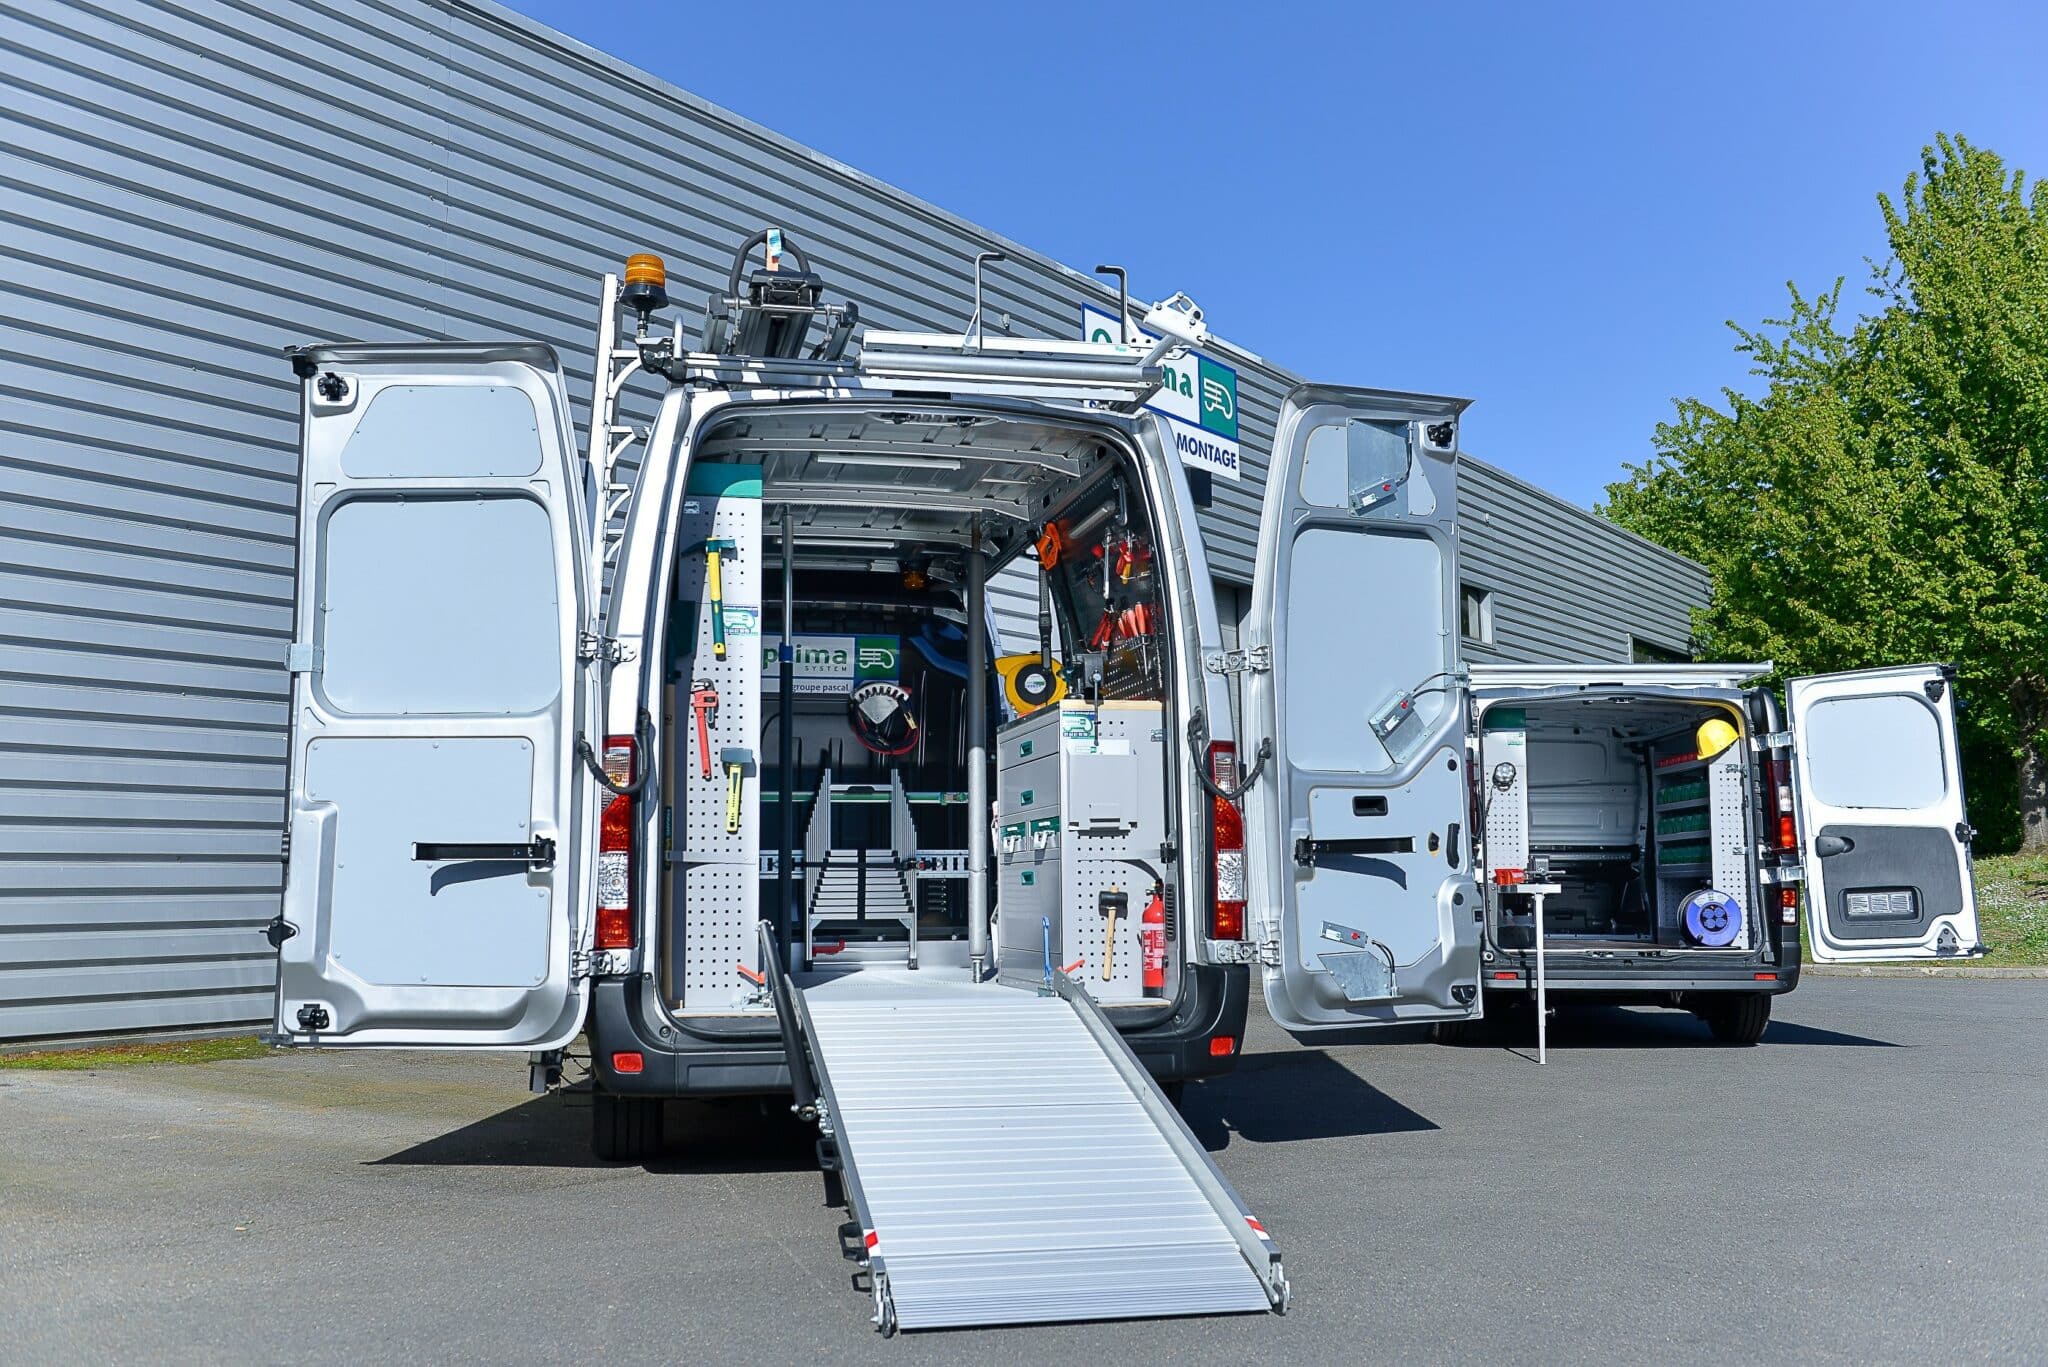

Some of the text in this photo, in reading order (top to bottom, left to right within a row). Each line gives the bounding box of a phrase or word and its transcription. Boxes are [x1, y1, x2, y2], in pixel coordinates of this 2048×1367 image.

[1176, 432, 1237, 470] MONTAGE
[763, 644, 848, 670] pima
[793, 683, 849, 693] groupe pascal
